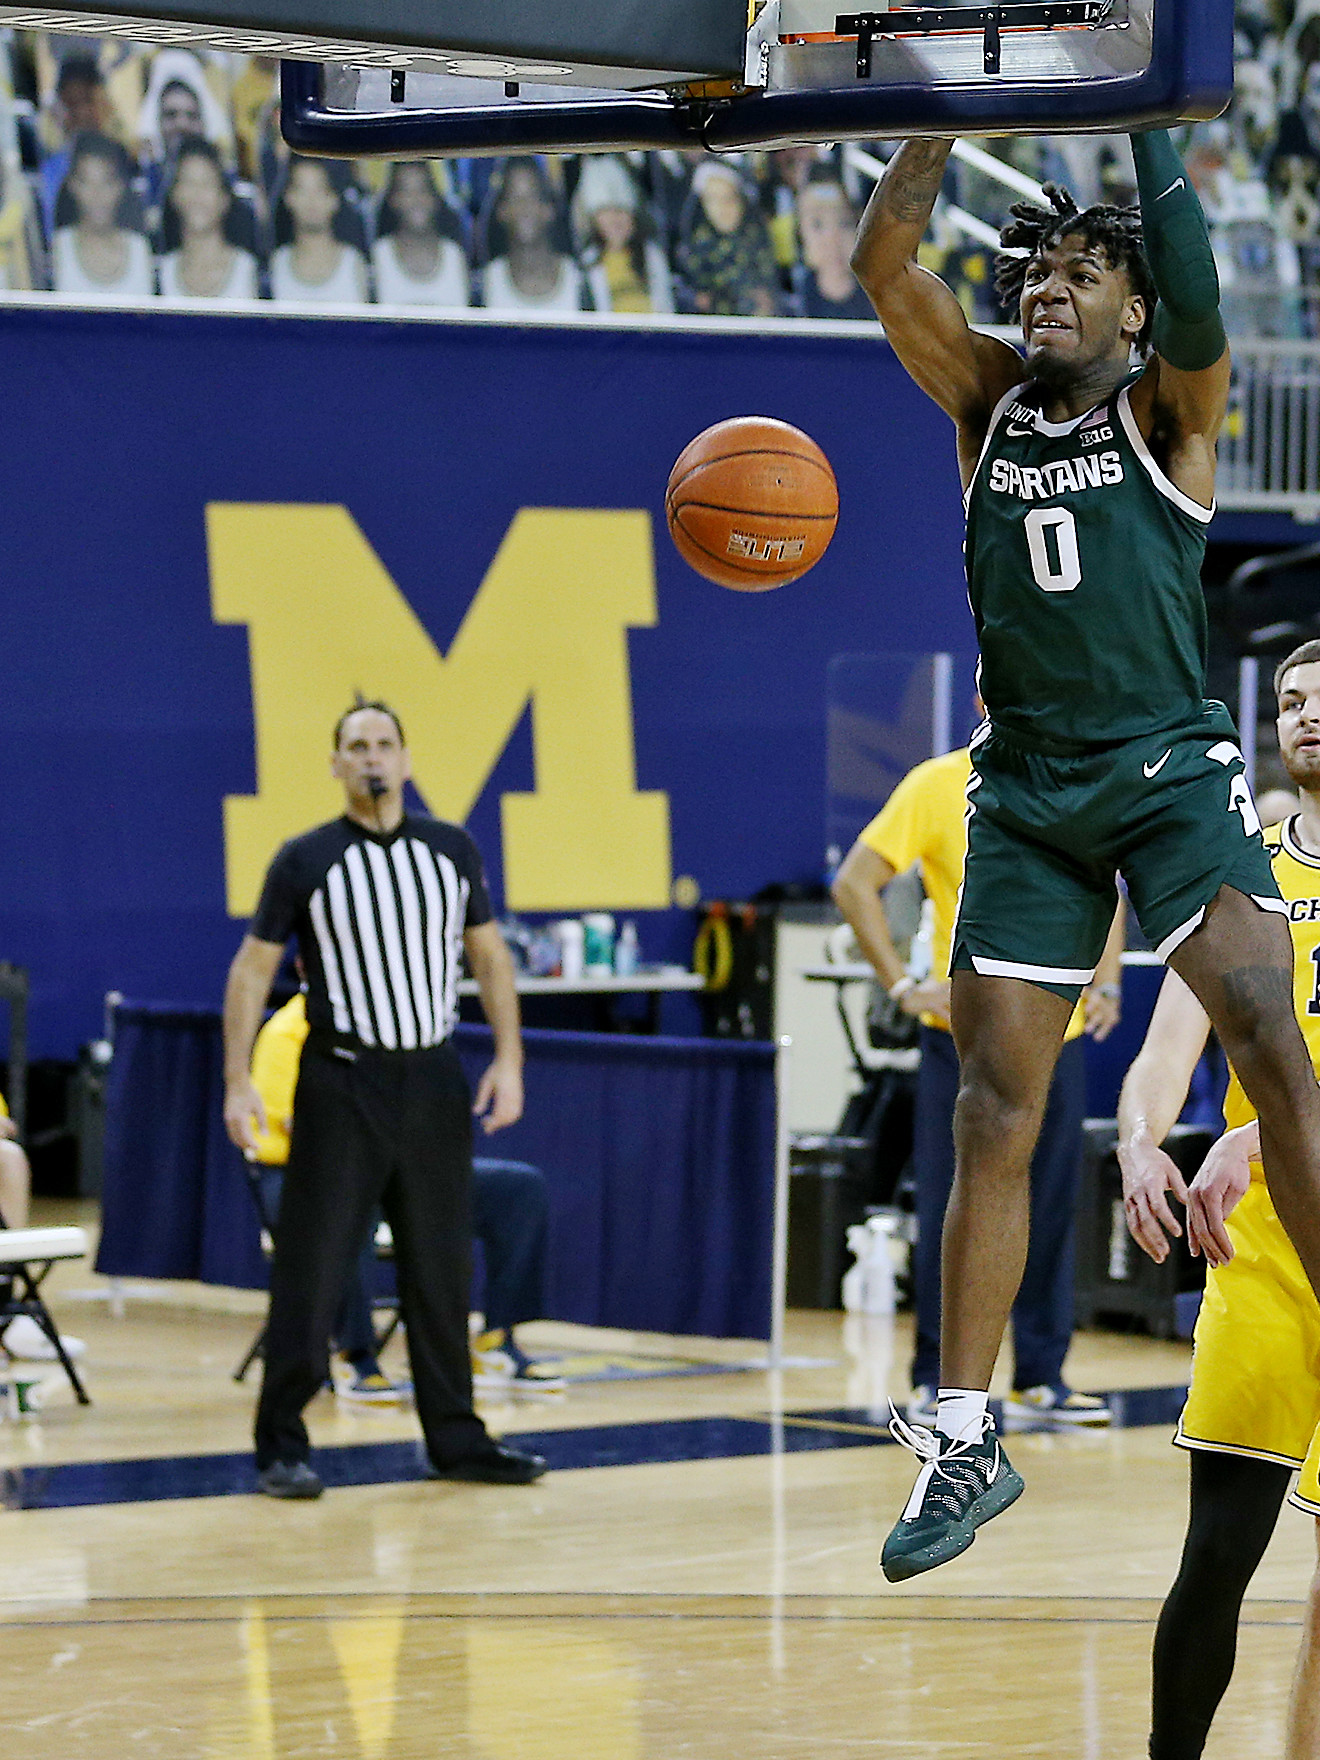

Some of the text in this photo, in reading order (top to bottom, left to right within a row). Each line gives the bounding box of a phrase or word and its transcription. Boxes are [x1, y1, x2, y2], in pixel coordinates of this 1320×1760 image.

[989, 450, 1125, 500] SPARTANS
[1023, 506, 1082, 592] 0
[205, 502, 672, 916] M
